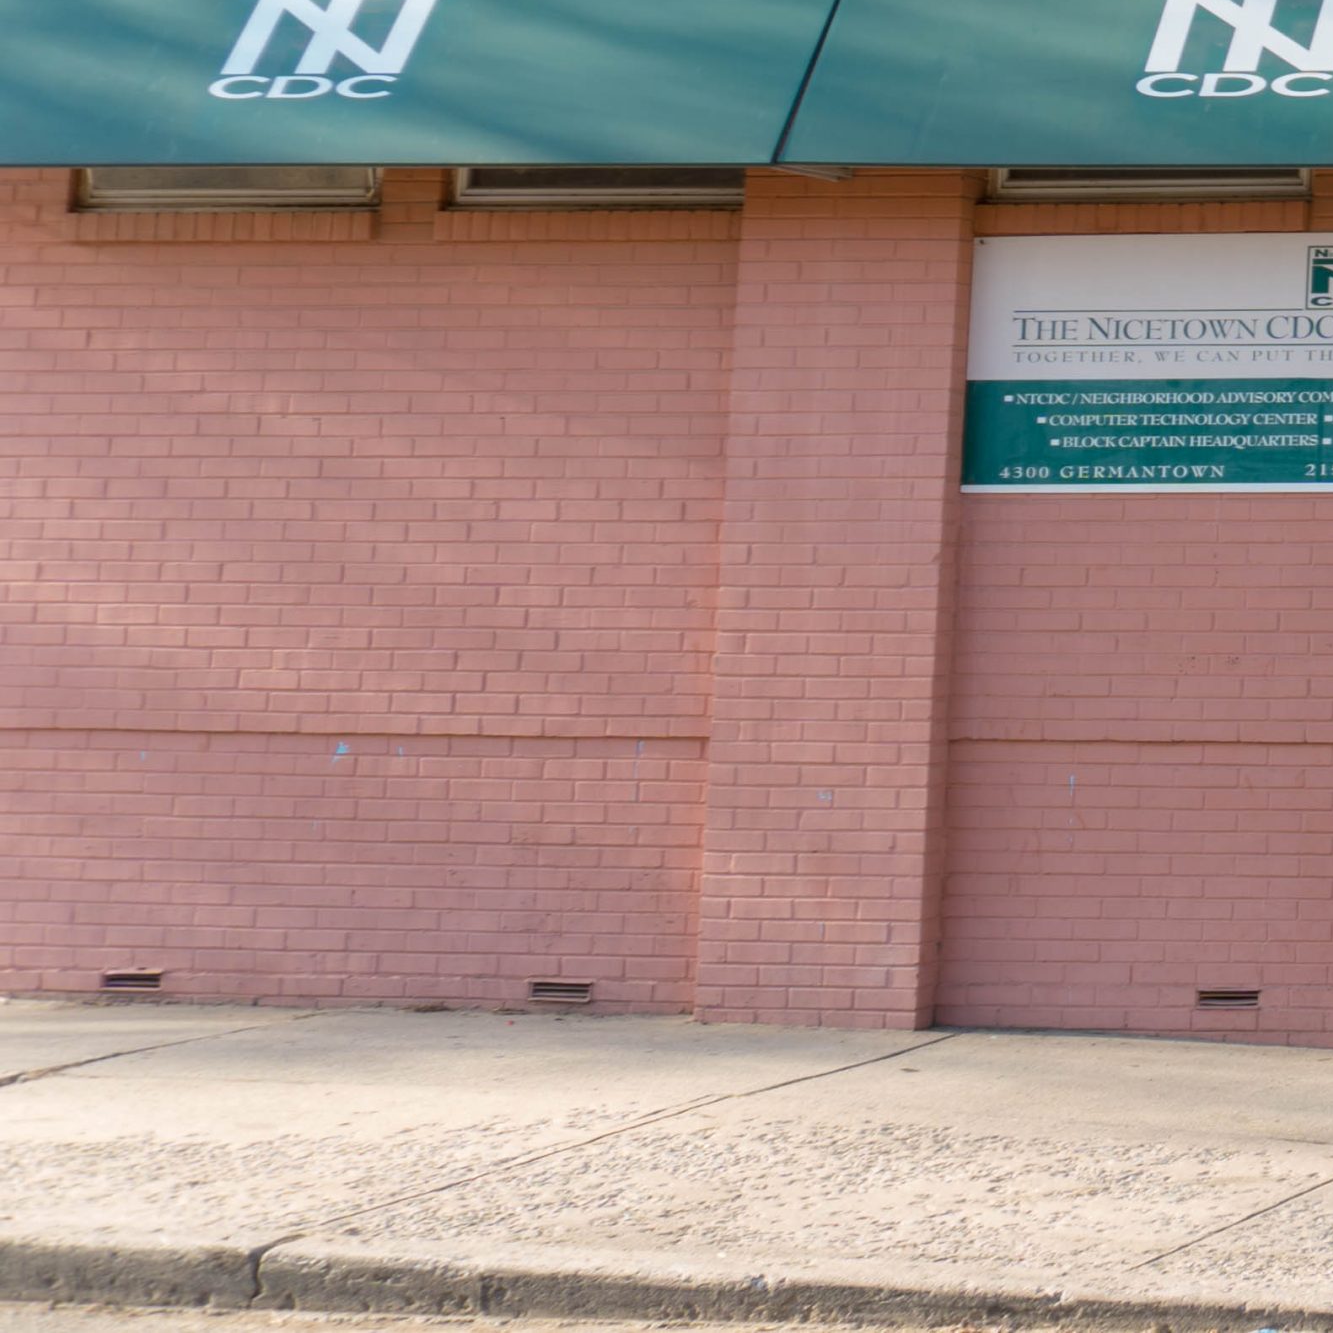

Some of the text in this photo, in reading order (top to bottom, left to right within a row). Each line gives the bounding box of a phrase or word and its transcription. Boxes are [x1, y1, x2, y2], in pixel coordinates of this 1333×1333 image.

[208, 75, 399, 99] CDC
[1136, 72, 1333, 97] CDC
[1013, 350, 1142, 364] TOGETHER,
[1155, 350, 1186, 363] WE
[1196, 350, 1240, 363] CAN
[1252, 349, 1296, 362] PUT
[1016, 392, 1070, 405] NTCDC
[1080, 392, 1214, 405] NEIGHBORHOOD
[1216, 391, 1297, 404] ADVISORY
[1049, 413, 1318, 426] COMPUTER TECHNOLOGY CENTER
[1062, 435, 1319, 450] BLOCK CAPTAIN HEADQUARTERS
[999, 465, 1225, 479] 4300 GERMANTOWN
